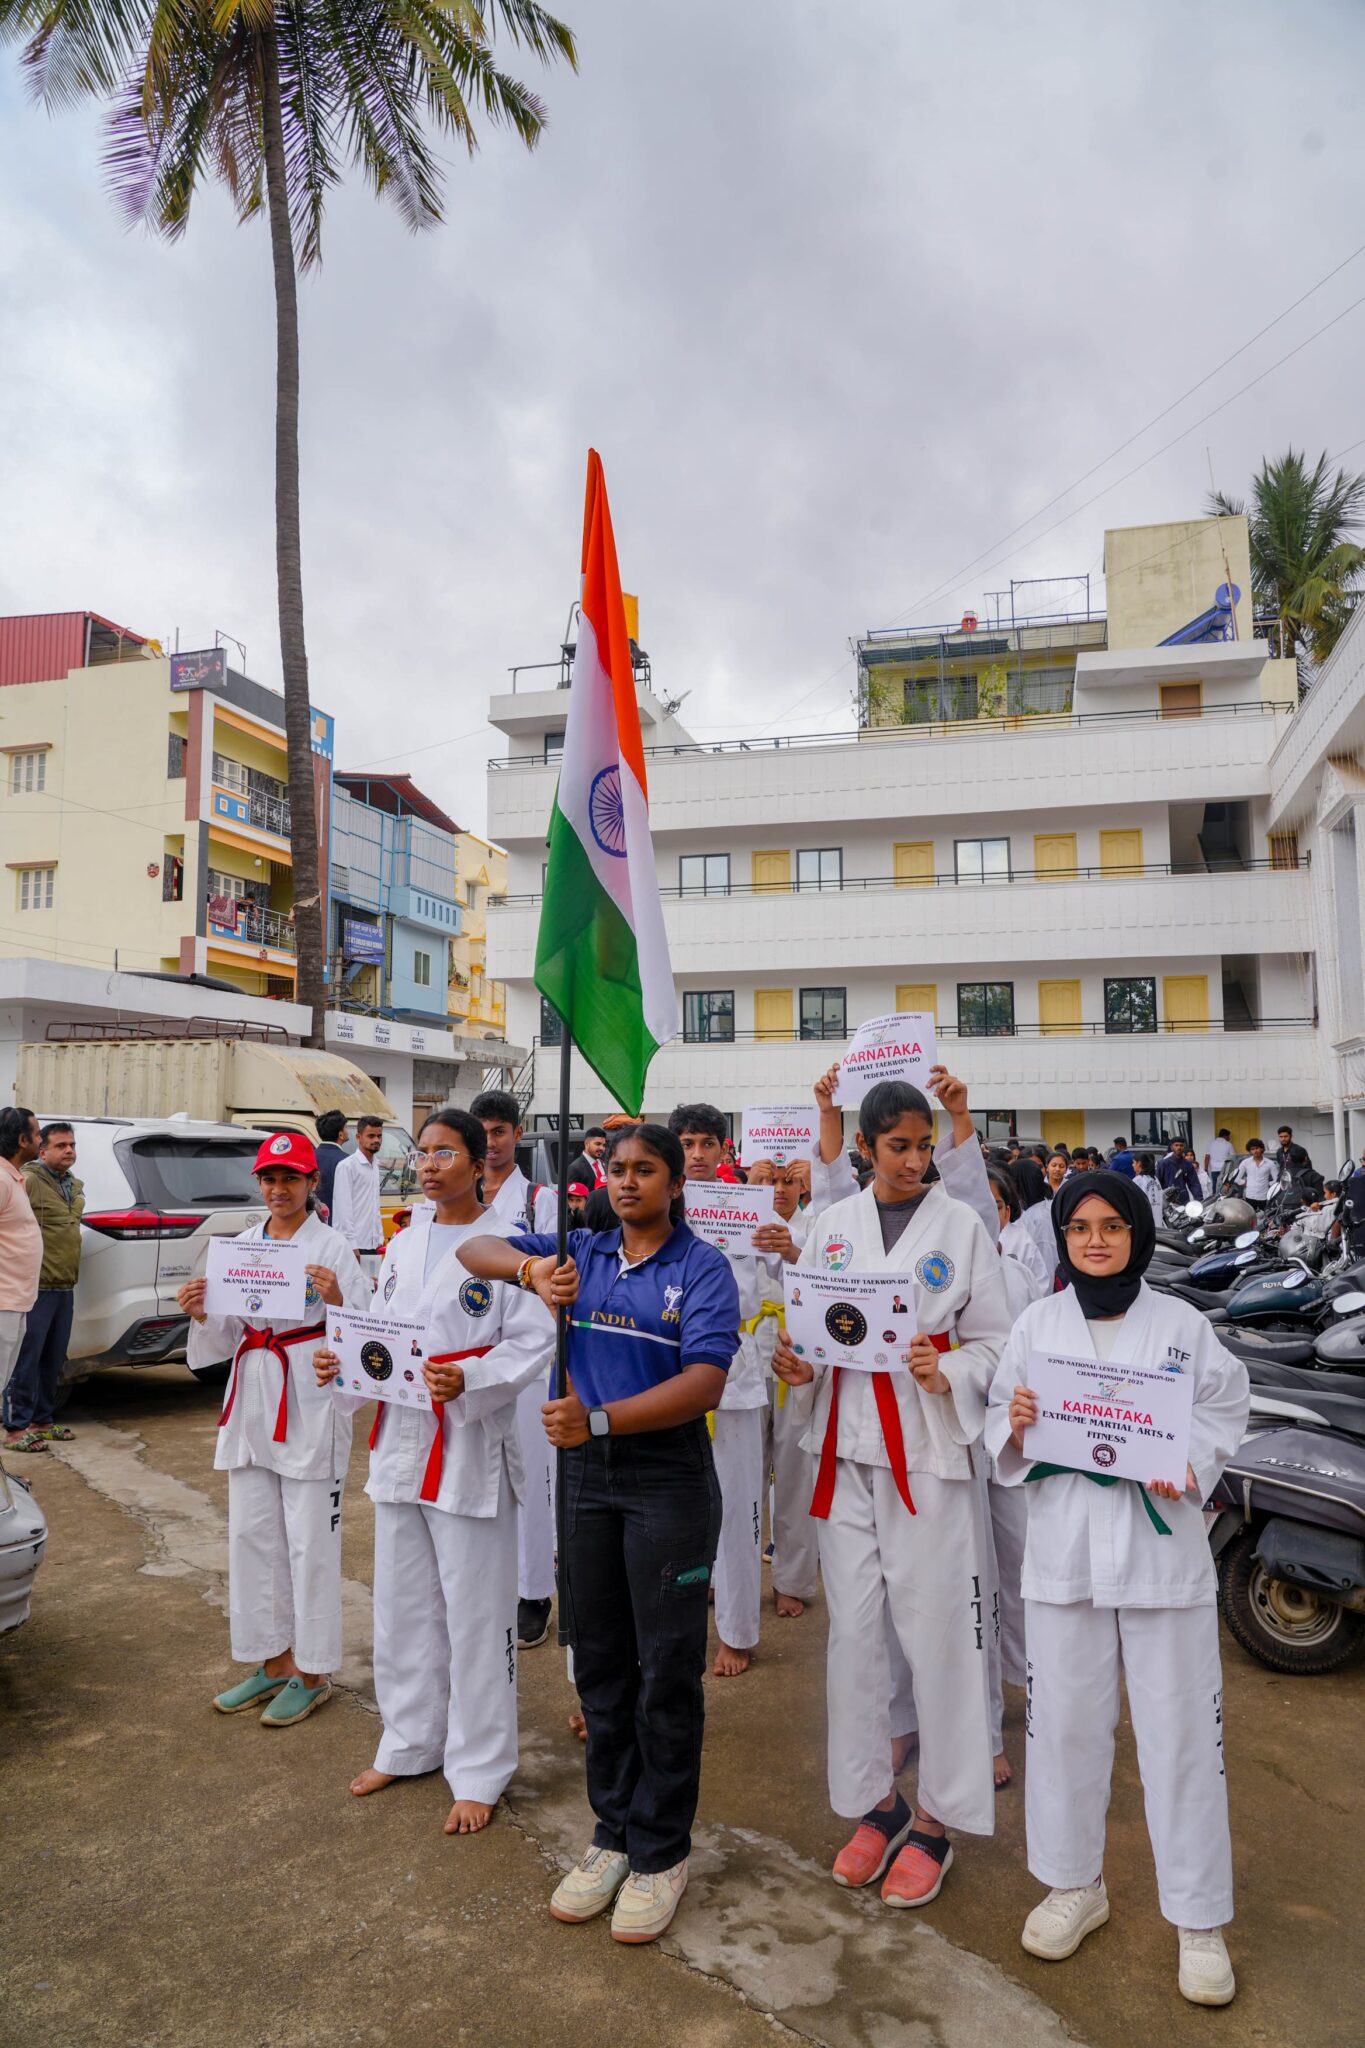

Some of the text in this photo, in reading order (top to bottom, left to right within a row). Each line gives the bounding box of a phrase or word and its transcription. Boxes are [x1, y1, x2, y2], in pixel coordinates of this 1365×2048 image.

[337, 1031, 354, 1039] LADIES
[375, 1035, 390, 1044] TOILET
[842, 1042, 922, 1066] KARNATAKA
[847, 1057, 921, 1073] BHARAT TAEKWON-DO
[863, 1068, 905, 1080] FEDERATION
[748, 1127, 811, 1137] KARNATAKA
[684, 1207, 759, 1222] KARNATAKA
[703, 1228, 742, 1236] FEDERATION
[716, 1221, 757, 1230] TAEKWON-DO
[228, 1268, 285, 1280] KARNATAKA
[801, 1272, 829, 1282] NATIONAL
[830, 1276, 850, 1284] LEVEL
[862, 1278, 910, 1286] TAEKWON-DO
[240, 1287, 272, 1295] ACADEMY
[810, 1283, 858, 1294] CHAMPIONSHIP
[1262, 1281, 1282, 1289] ROYA
[590, 1310, 637, 1328] INDIA
[349, 1322, 386, 1333] CHAMPIONSHIP
[1168, 1346, 1192, 1362] ITF
[1066, 1360, 1097, 1371] NATIONAL
[1098, 1365, 1119, 1374] LEVEL
[1120, 1368, 1130, 1376] ITF
[1132, 1370, 1176, 1383] TAEKWON-DO
[1076, 1370, 1144, 1386] CHAMPIONSHIP 2025
[1063, 1400, 1153, 1426] KARNATAKA
[1042, 1410, 1176, 1440] EXTREME MARTIAL ARTS &
[1087, 1430, 1127, 1444] FITNESS
[1255, 1457, 1337, 1478] Activa
